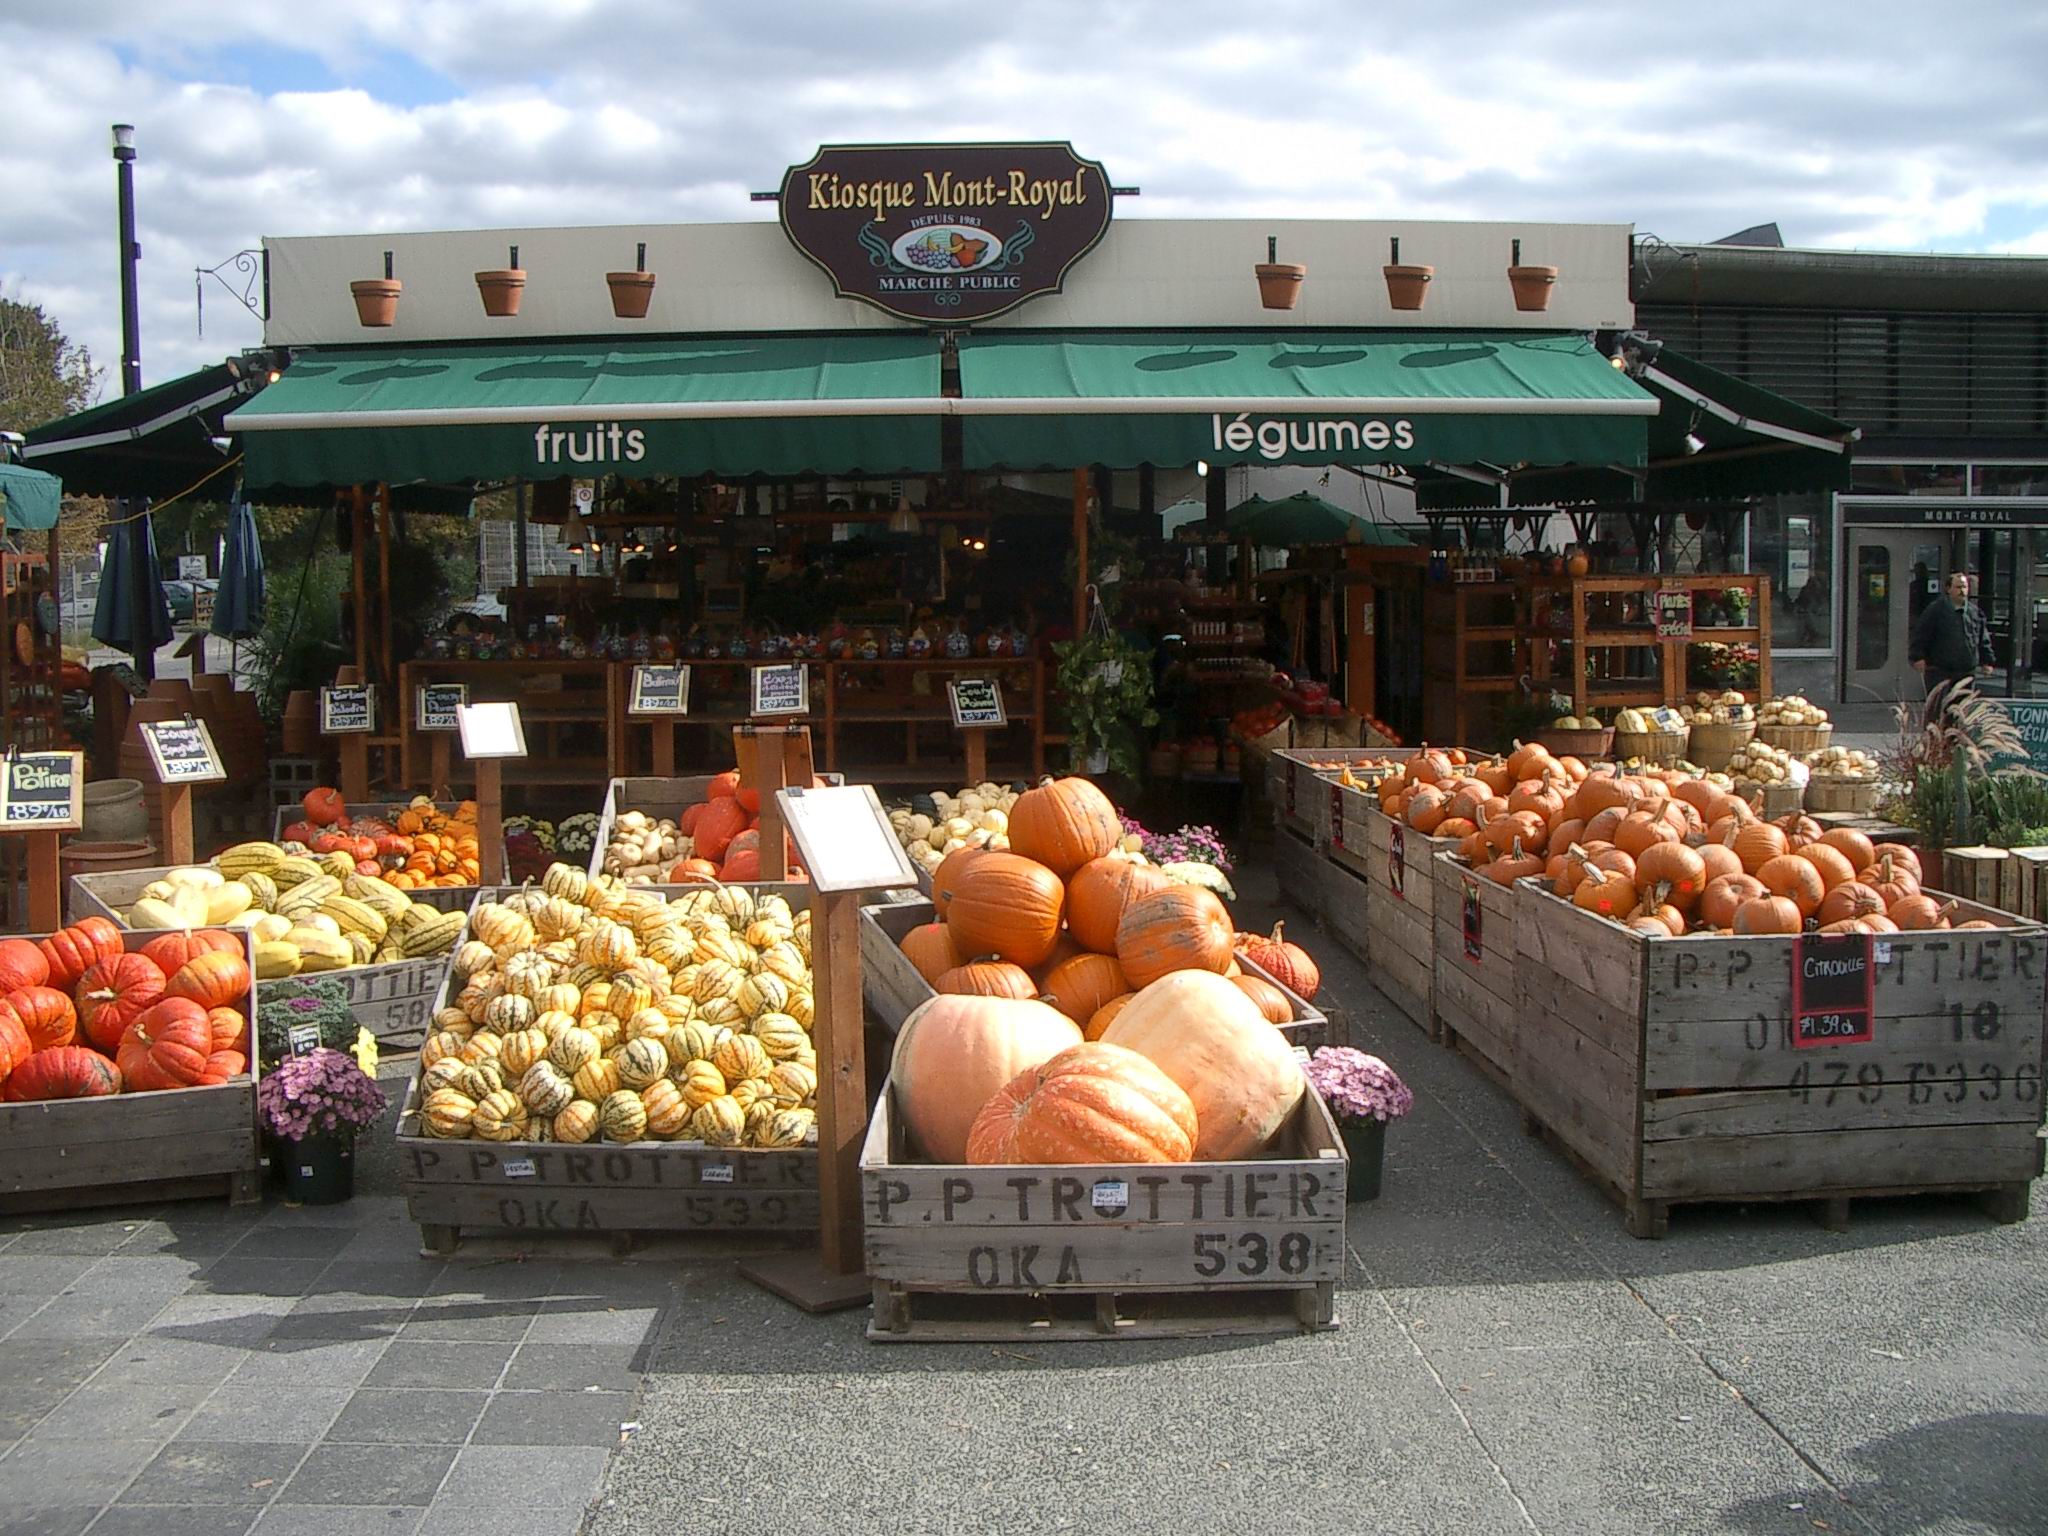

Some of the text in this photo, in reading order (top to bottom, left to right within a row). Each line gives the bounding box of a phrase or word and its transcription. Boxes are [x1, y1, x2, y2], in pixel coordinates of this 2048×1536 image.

[807, 167, 1087, 221] Kiosque Mont-Royal
[910, 214, 982, 229] DEPUIS 1983
[959, 275, 1021, 290] PUBLIC
[534, 423, 646, 463] fruits
[1212, 413, 1415, 460] légumes
[1924, 511, 2011, 521] MONT-ROYAL
[499, 1199, 598, 1229] OKA
[968, 1232, 1311, 1288] OKA 538
